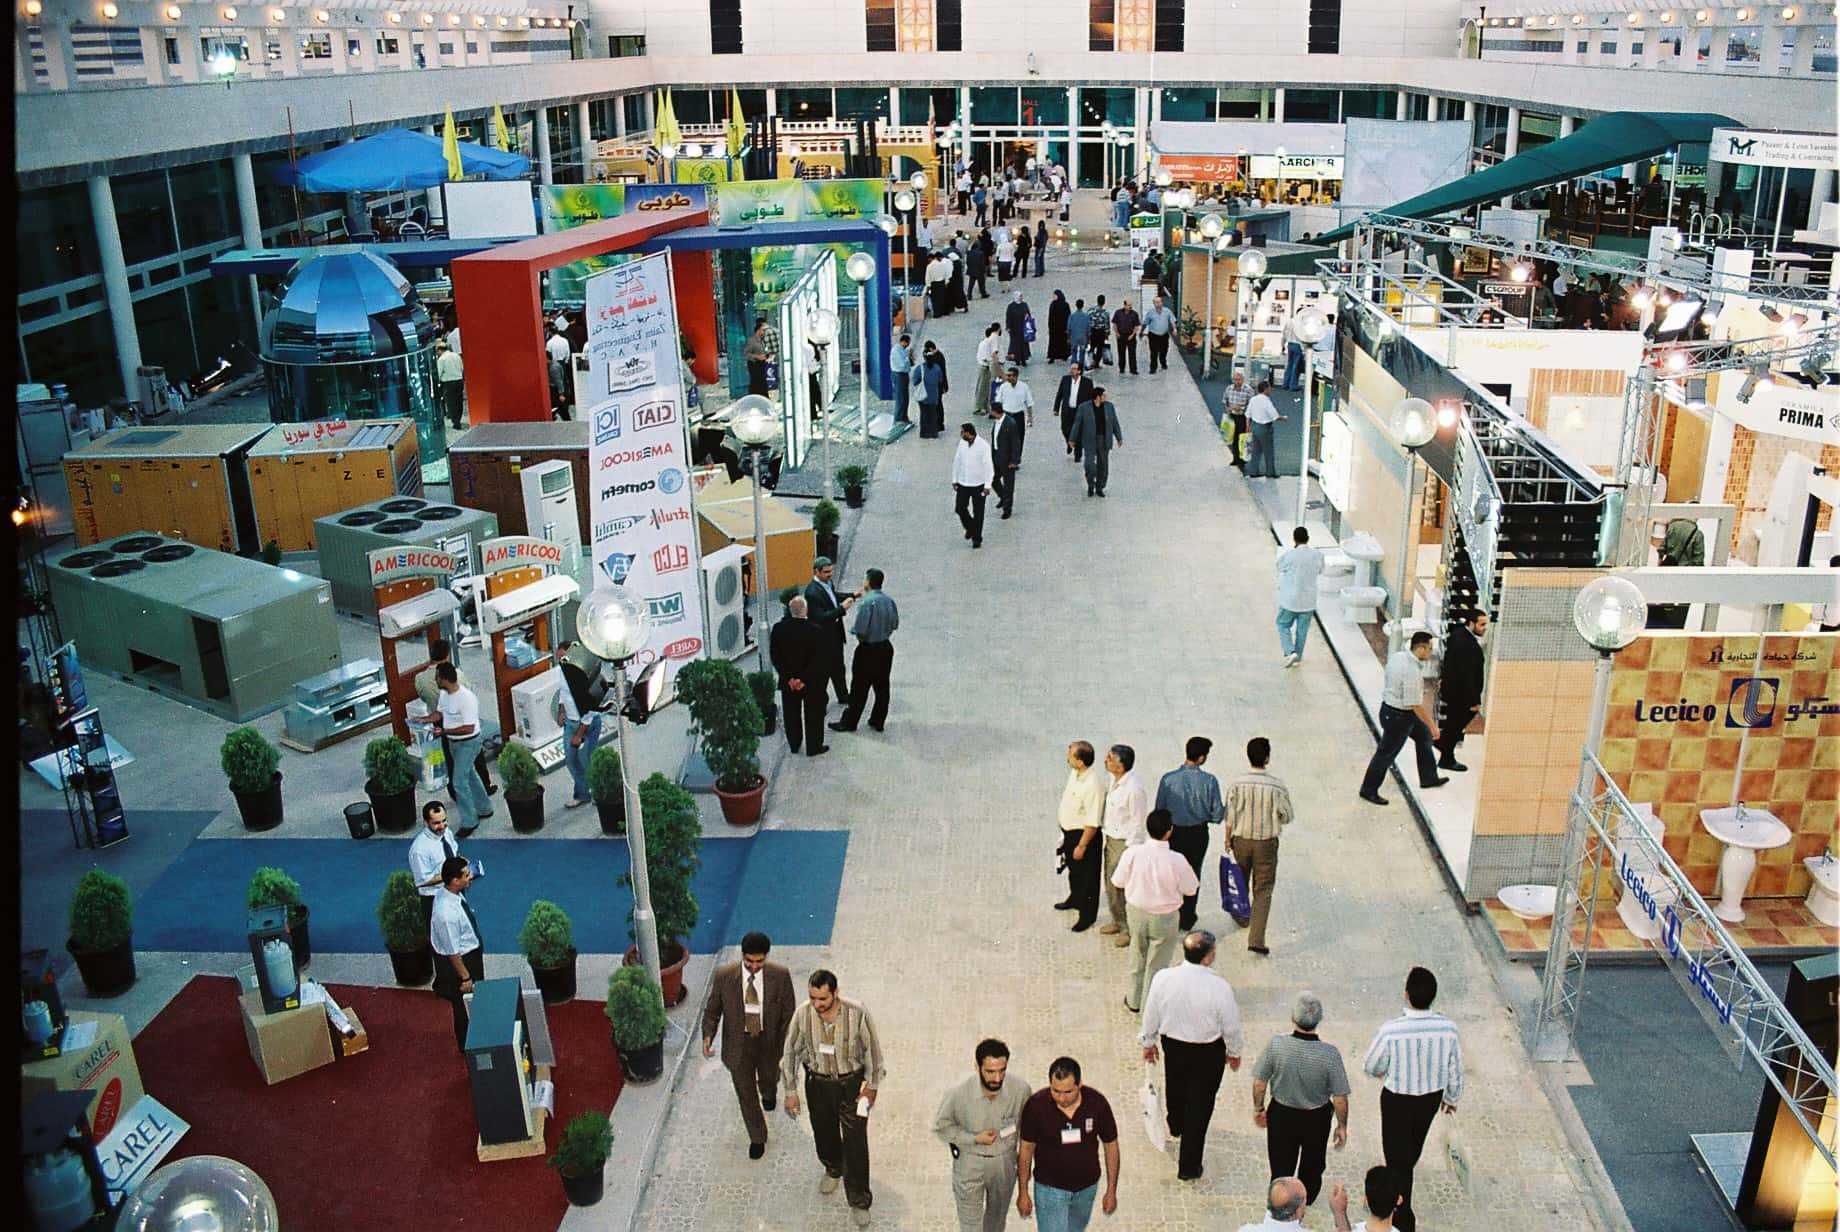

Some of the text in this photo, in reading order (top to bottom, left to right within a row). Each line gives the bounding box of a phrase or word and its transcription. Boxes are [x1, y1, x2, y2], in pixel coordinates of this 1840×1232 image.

[1022, 106, 1034, 126] 1
[1779, 407, 1824, 429] PRIMA
[373, 554, 456, 575] AMERICOOL
[485, 543, 561, 565] AMERICOOL
[1634, 698, 1717, 723] Lecico
[1620, 853, 1656, 920] Lecico
[74, 1040, 112, 1079] CAREL
[101, 1113, 168, 1184] CAREL
